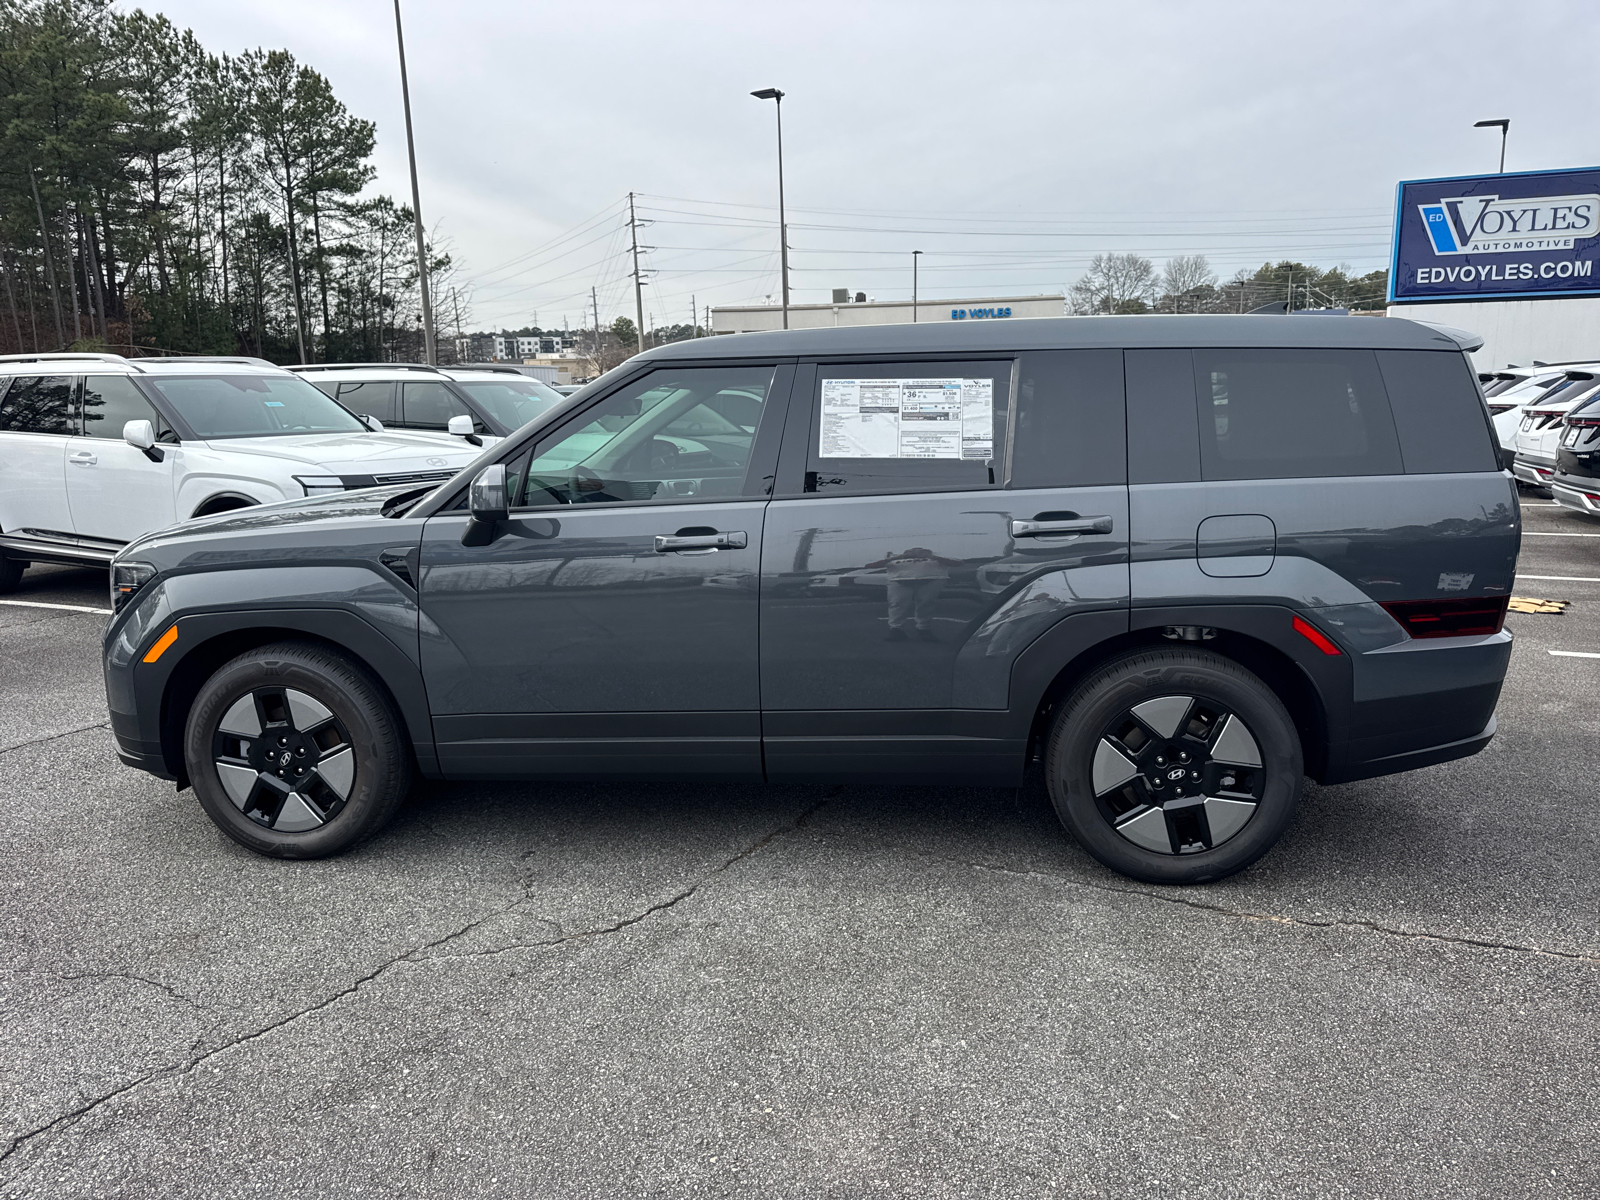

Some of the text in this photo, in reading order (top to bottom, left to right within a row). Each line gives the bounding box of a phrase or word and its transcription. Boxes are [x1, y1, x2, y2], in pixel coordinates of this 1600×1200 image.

[1429, 198, 1591, 247] ED VOYLES
[1472, 239, 1571, 251] AUTOMOTIVE
[1416, 260, 1593, 284] EDVOYLES.COM
[951, 307, 1012, 320] ED VOYLES
